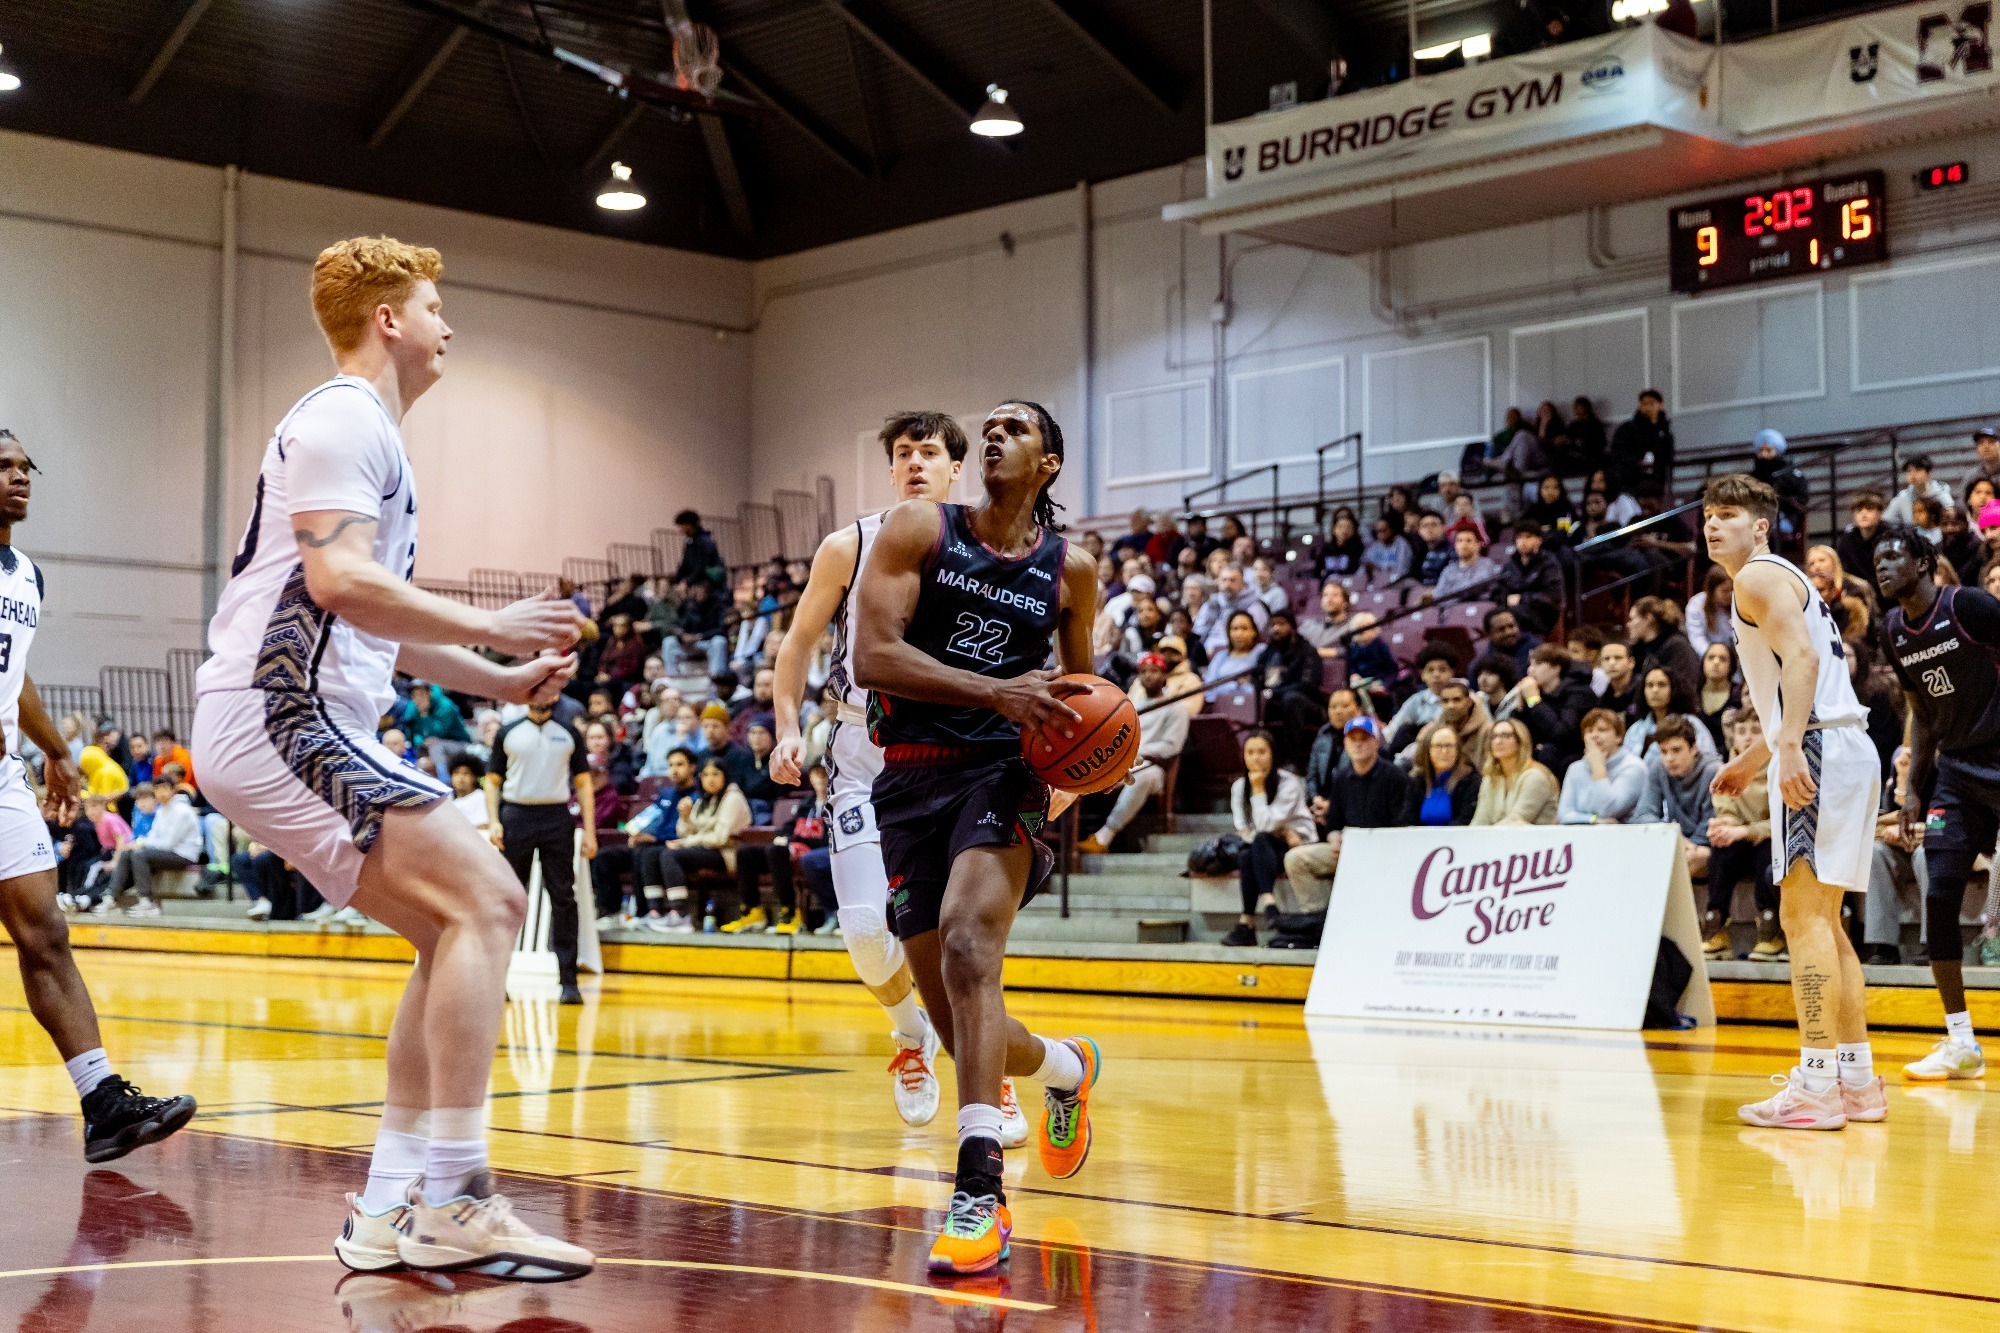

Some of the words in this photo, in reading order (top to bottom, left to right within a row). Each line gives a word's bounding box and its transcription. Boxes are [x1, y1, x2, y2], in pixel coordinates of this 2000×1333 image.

[1258, 99, 1454, 173] BURRIDGE
[1465, 72, 1564, 121] GYM
[1744, 187, 1813, 236] 2:02
[1842, 198, 1872, 240] 15
[1697, 226, 1718, 266] 9
[1809, 238, 1819, 265] 1
[936, 568, 1048, 617] MARAUDERS
[1028, 567, 1052, 582] OUA
[0, 595, 37, 629] EHEAD
[946, 611, 1012, 665] 22
[1900, 637, 1960, 668] MARAUDERS
[1922, 665, 1955, 698] 21
[1062, 721, 1132, 782] Wilson
[1410, 842, 1574, 920] Campus
[1466, 898, 1556, 945] Store
[1469, 953, 1509, 970] SUPPORT
[1807, 1058, 1824, 1069] 23
[1840, 1052, 1856, 1063] 23
